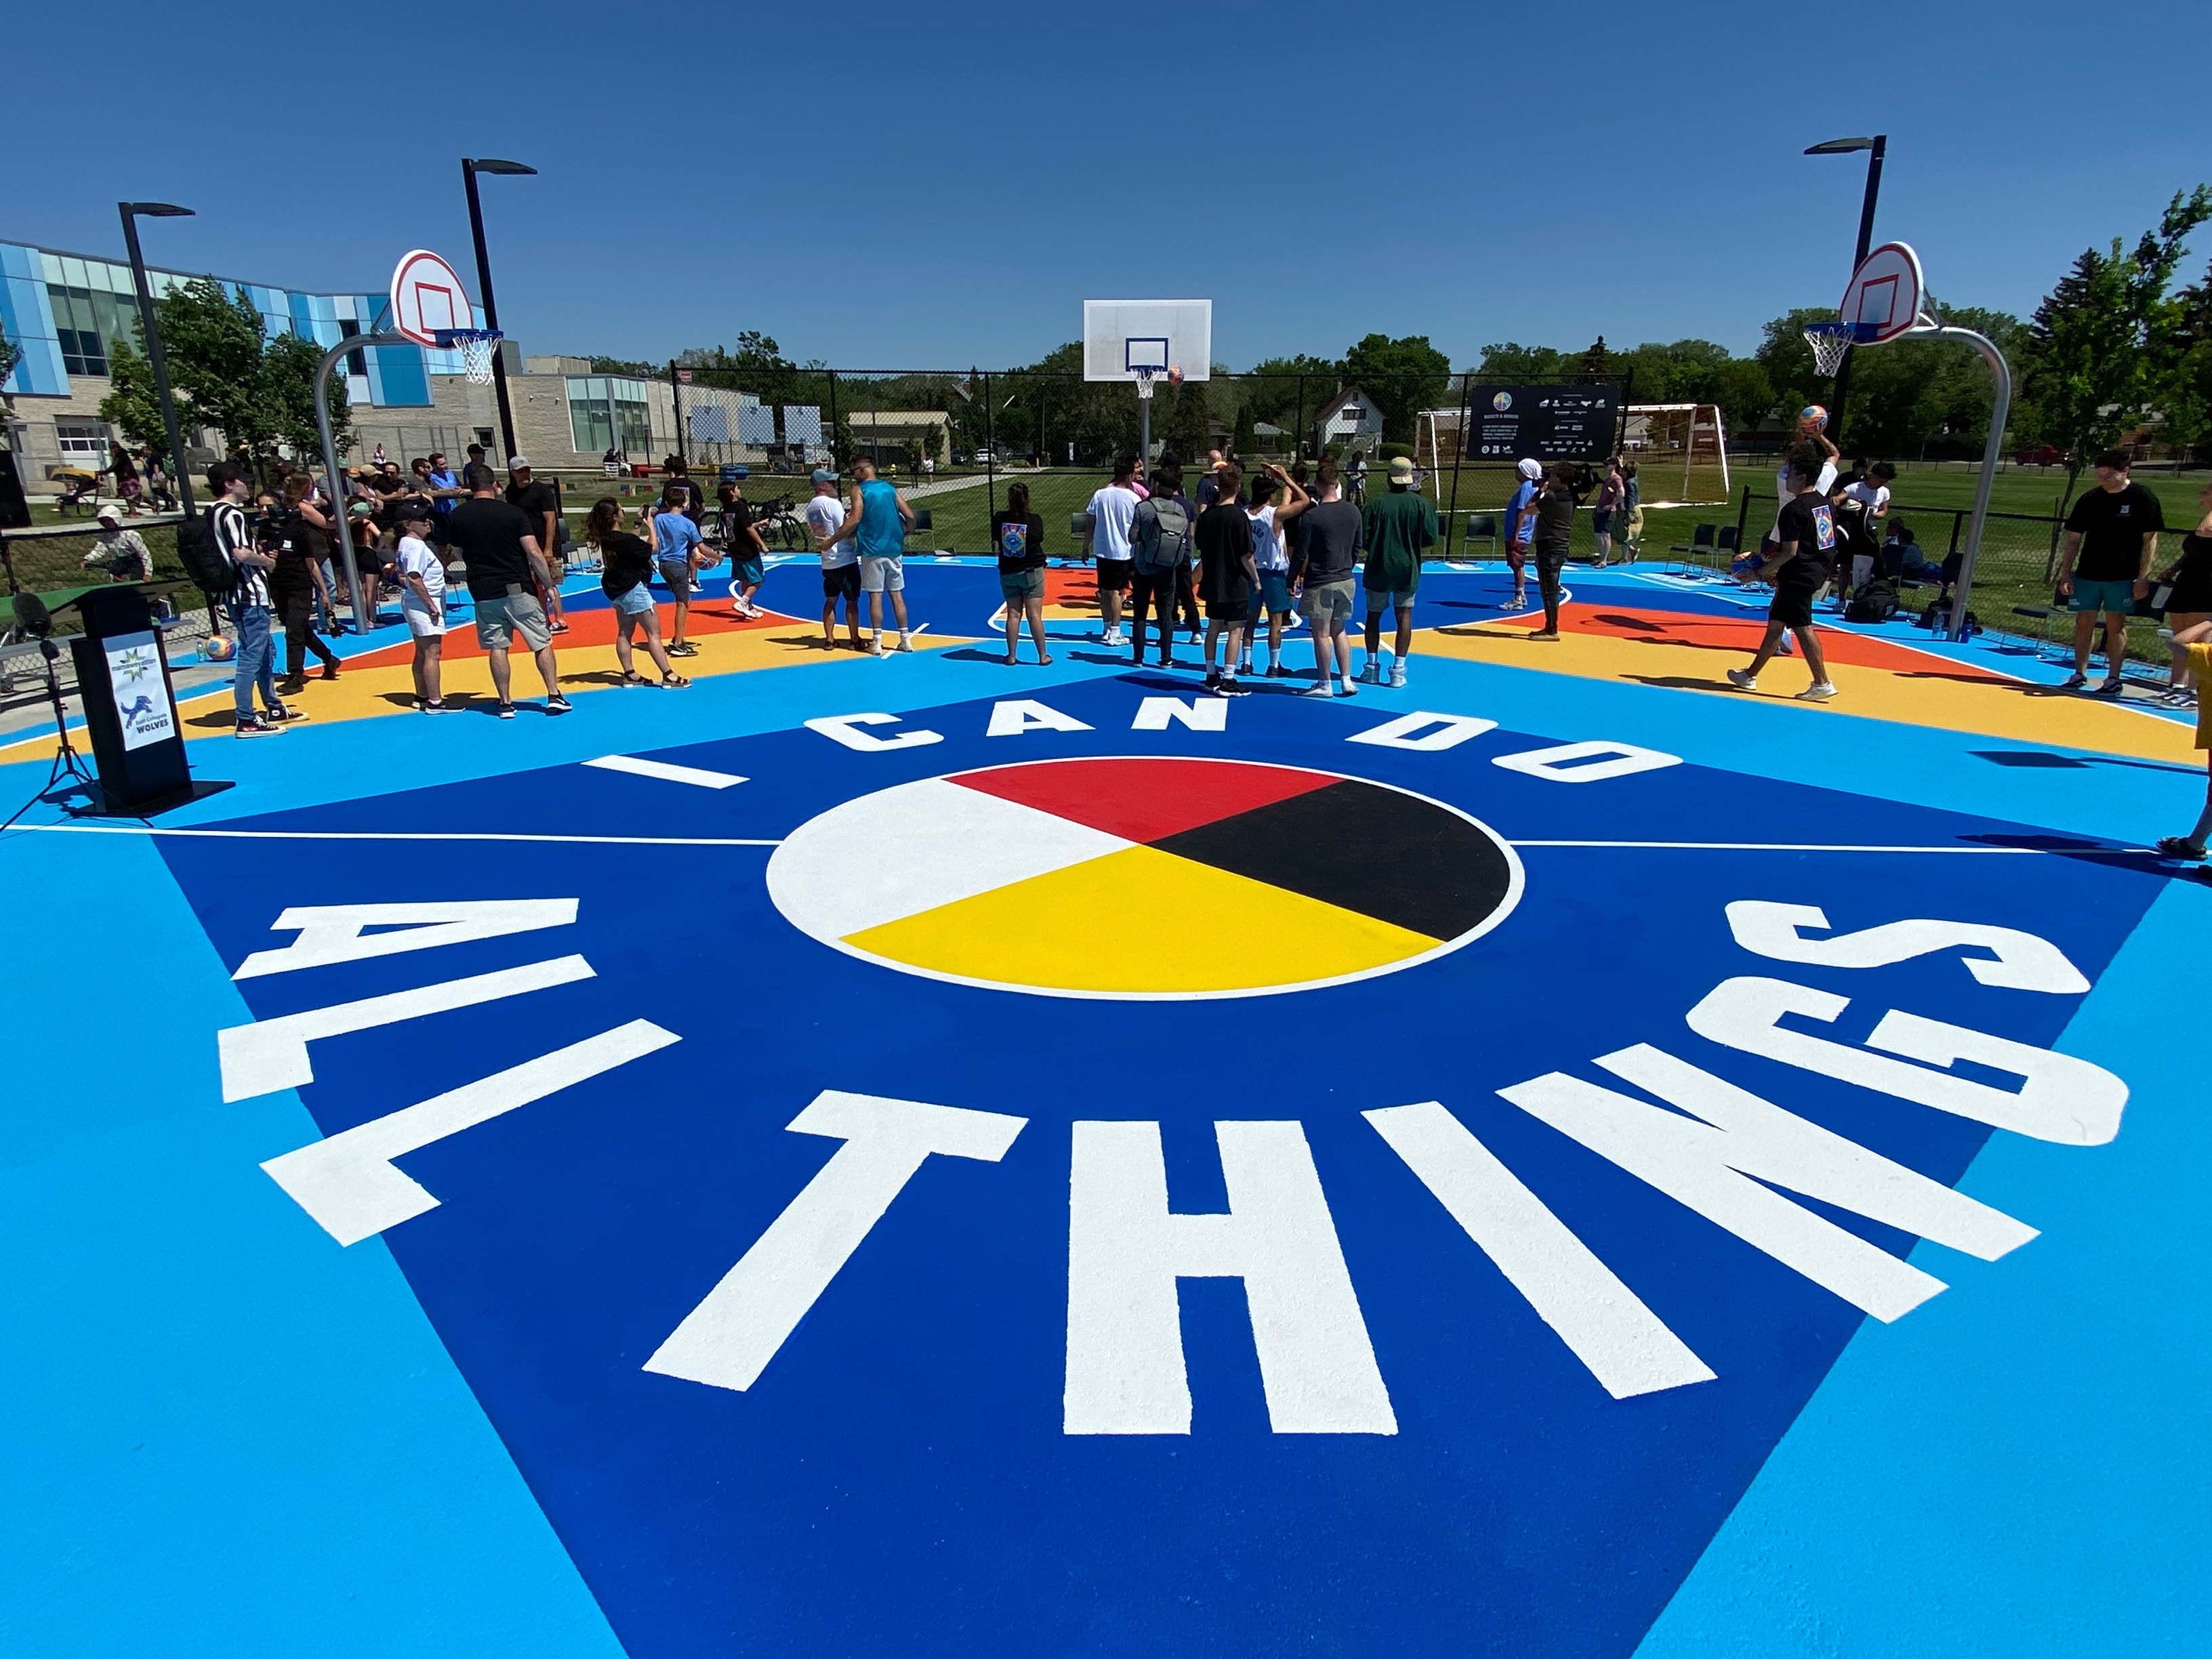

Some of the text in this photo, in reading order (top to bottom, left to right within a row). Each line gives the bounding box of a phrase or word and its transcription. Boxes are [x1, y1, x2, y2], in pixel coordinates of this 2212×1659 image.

[136, 718, 169, 734] WOLVES
[581, 697, 1683, 790] I CAN DO
[218, 898, 2129, 1436] ALL THINGS
